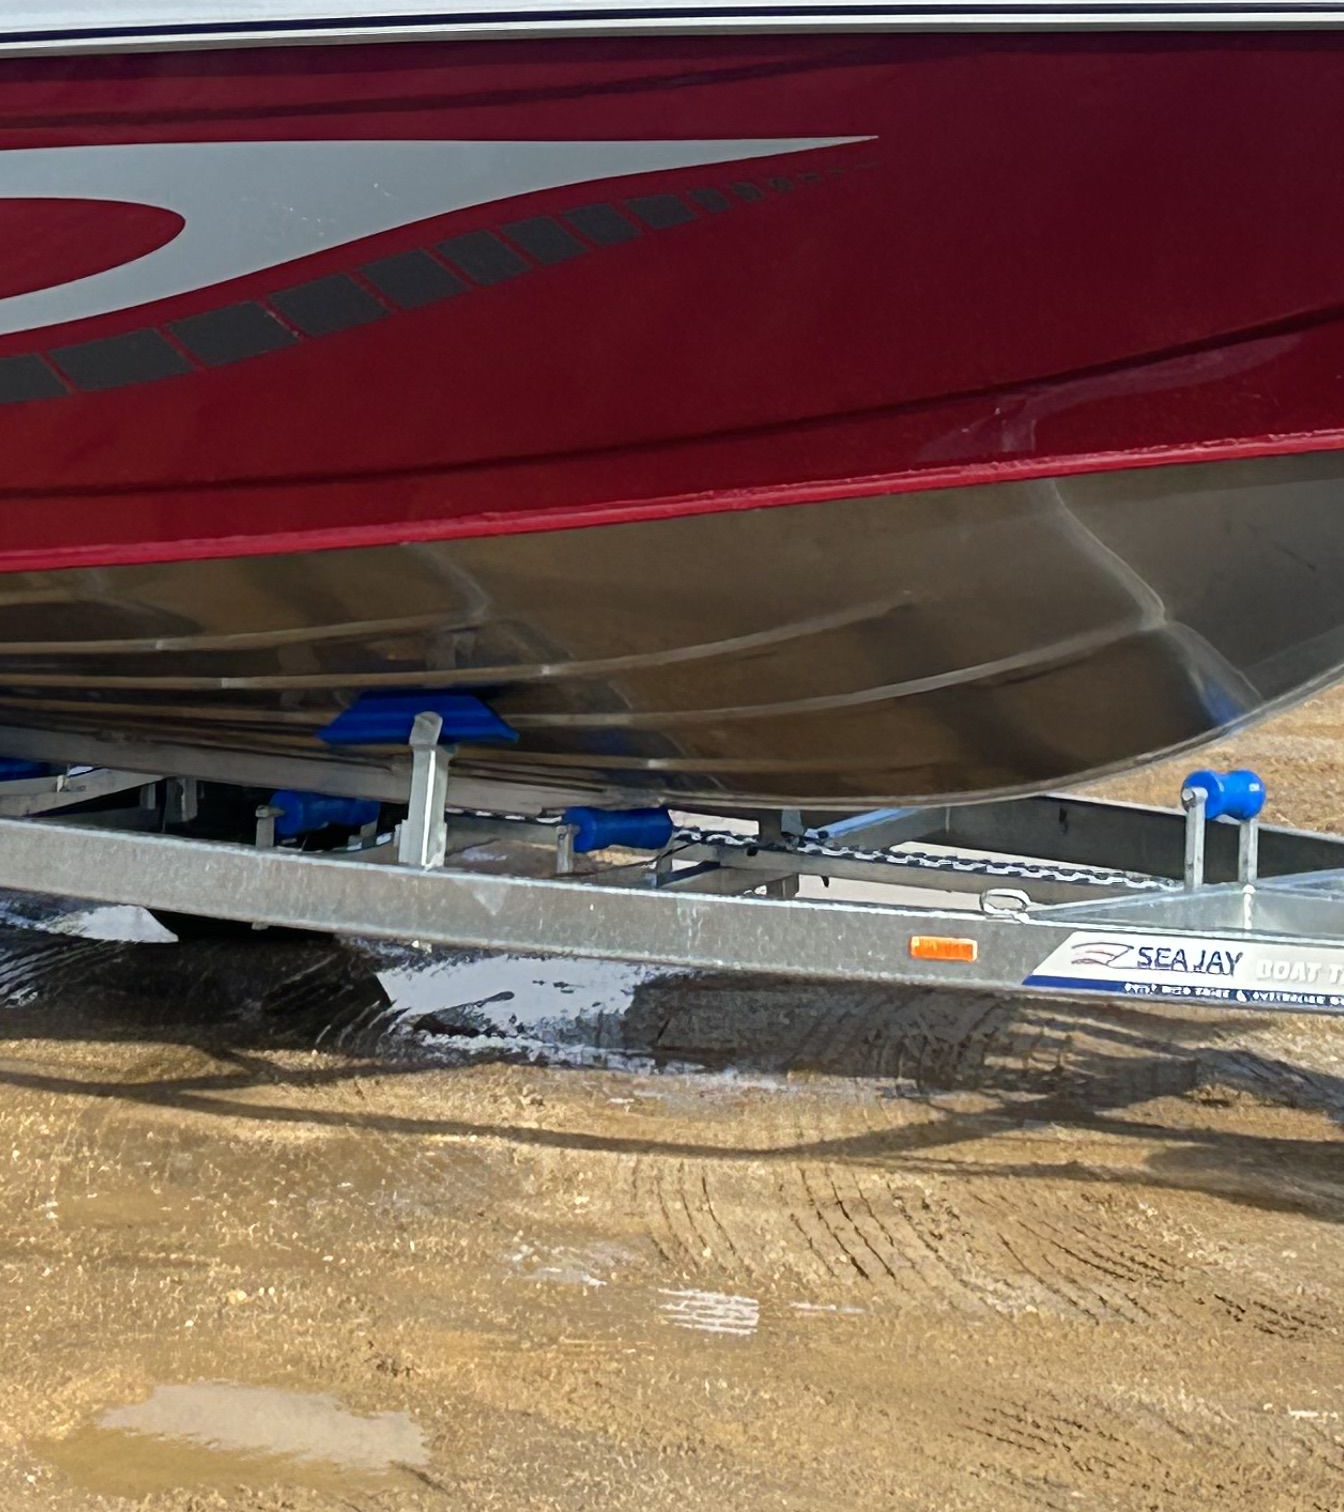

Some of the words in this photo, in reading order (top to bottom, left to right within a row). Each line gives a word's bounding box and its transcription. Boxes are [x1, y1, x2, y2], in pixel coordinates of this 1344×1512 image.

[1137, 946, 1188, 973] SEA
[1193, 949, 1244, 977] JAY
[1256, 959, 1322, 982] BOAT
